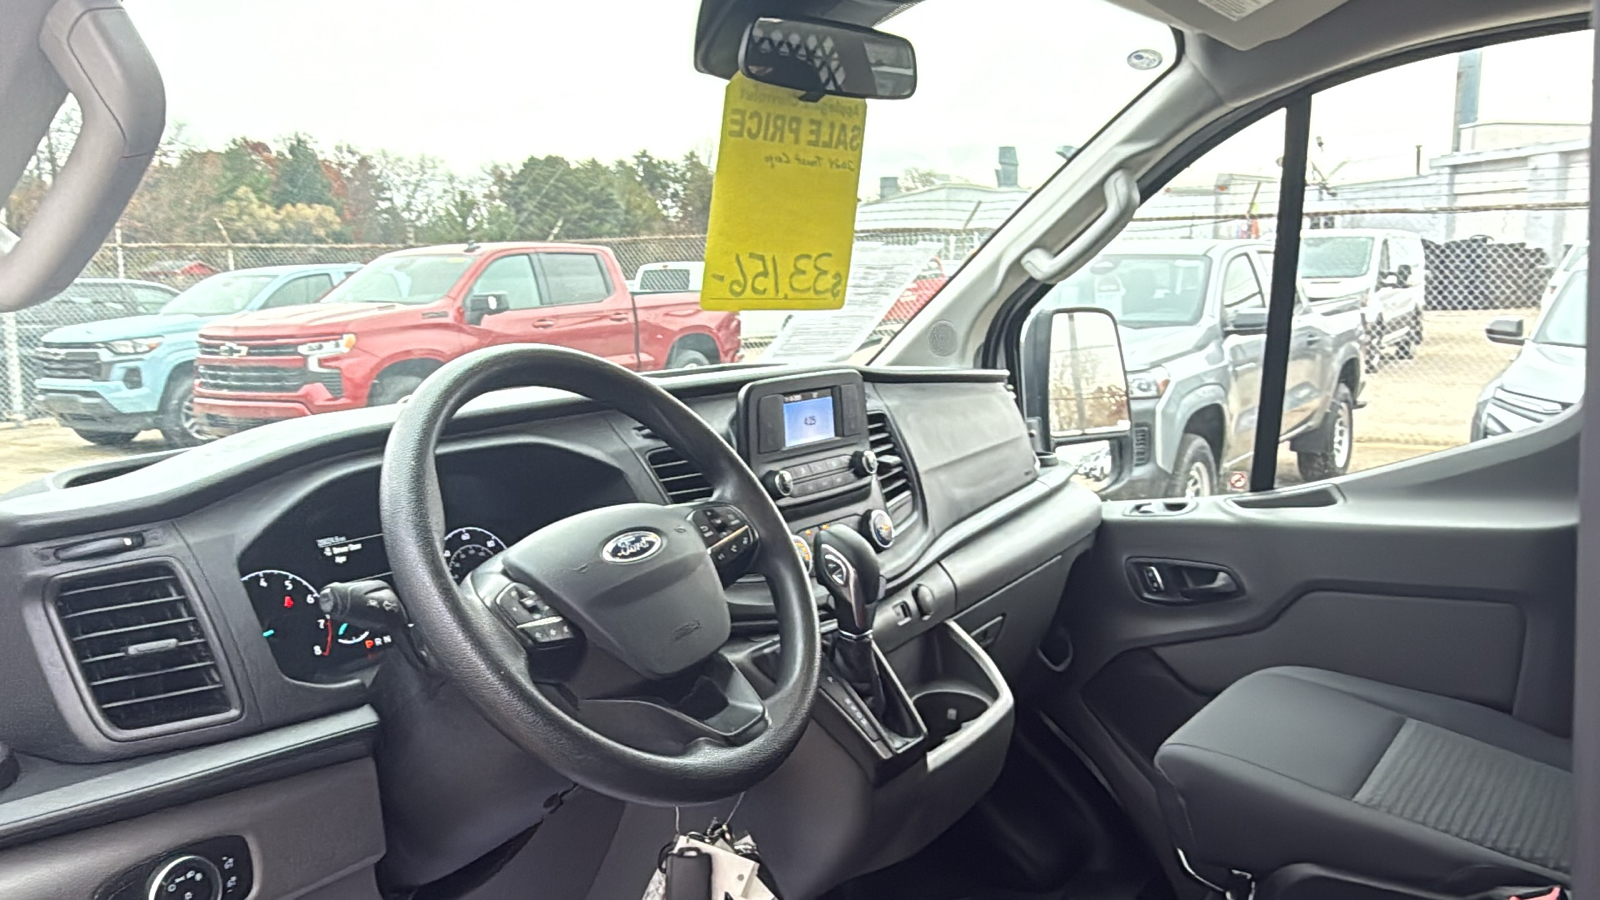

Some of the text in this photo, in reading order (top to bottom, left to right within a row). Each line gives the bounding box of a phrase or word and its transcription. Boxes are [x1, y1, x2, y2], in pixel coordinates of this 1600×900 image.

[284, 580, 293, 590] 5
[306, 594, 315, 604] 6
[317, 619, 325, 629] 7
